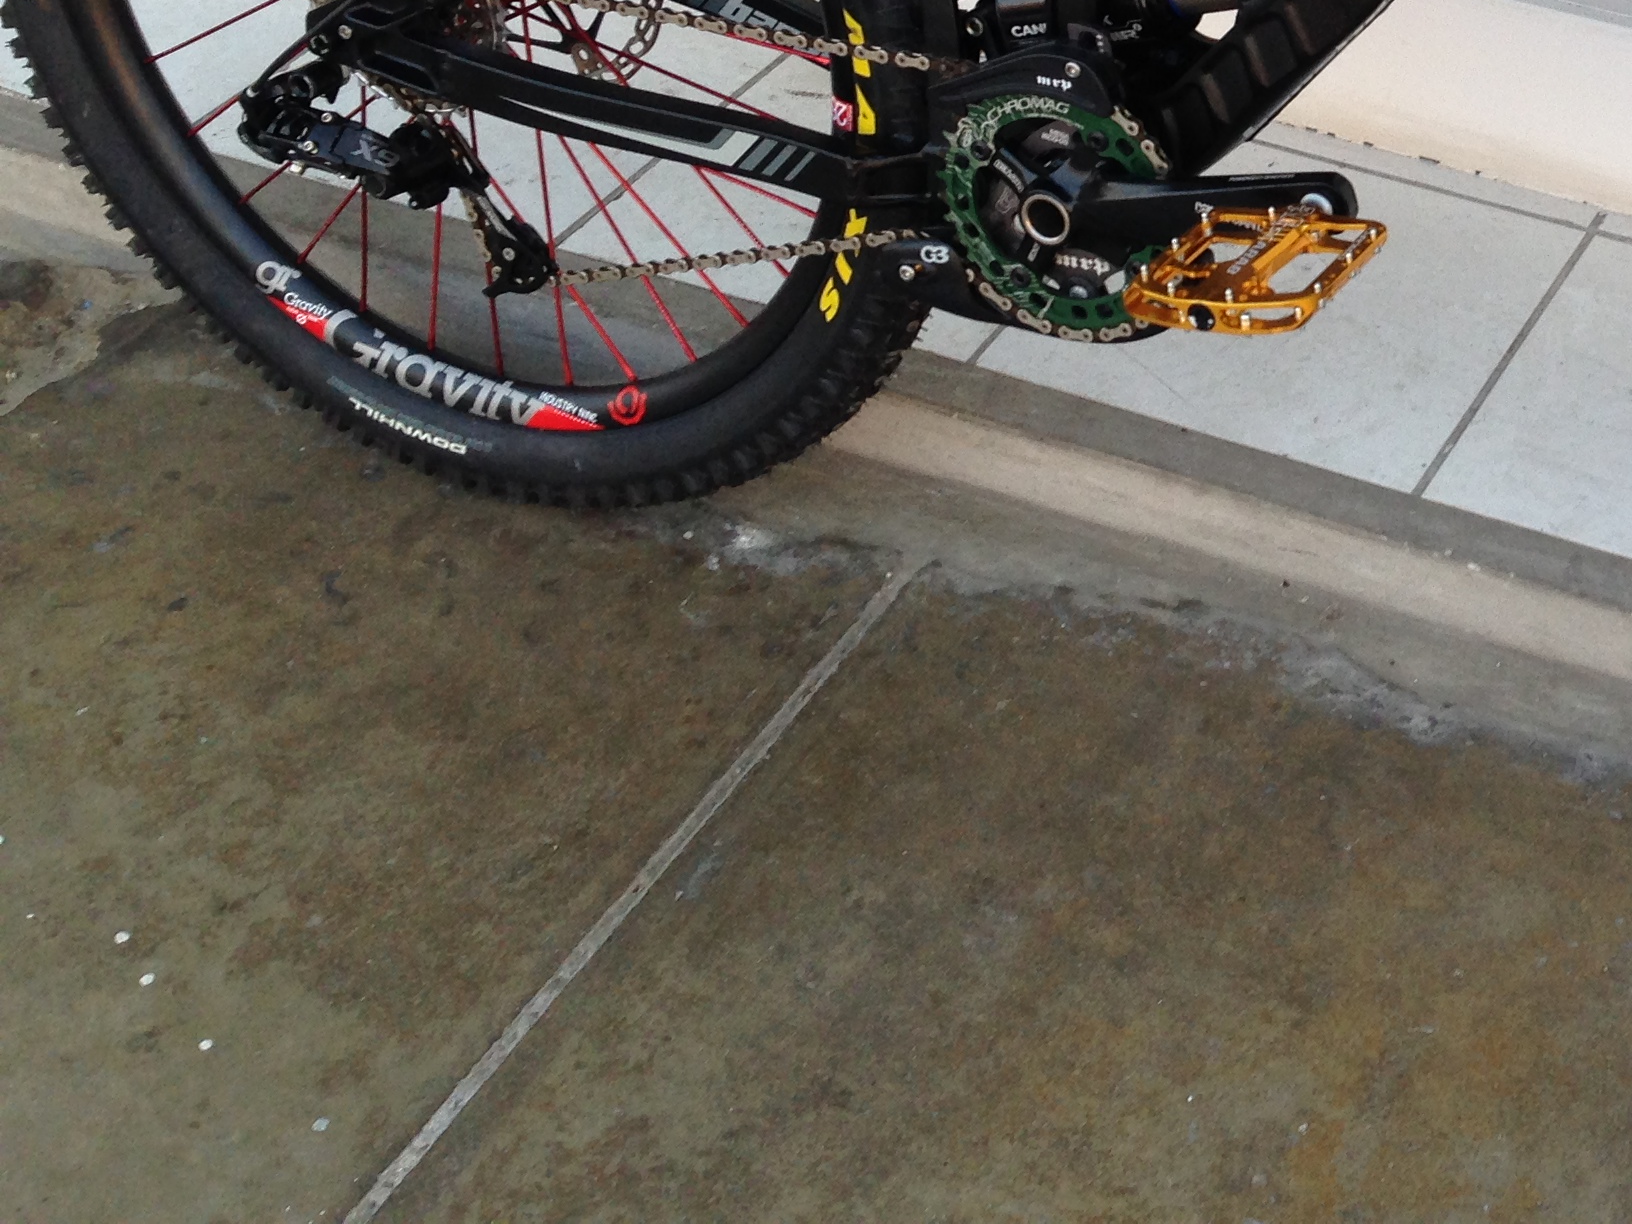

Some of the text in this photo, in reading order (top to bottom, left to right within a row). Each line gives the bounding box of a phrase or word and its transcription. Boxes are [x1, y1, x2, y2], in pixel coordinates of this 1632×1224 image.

[986, 97, 1071, 122] CHROMAG
[919, 244, 950, 264] G3
[255, 260, 302, 294] gr
[283, 291, 333, 320] Gravity
[325, 308, 546, 427] Gravity
[348, 396, 469, 456] DOWNHILL
